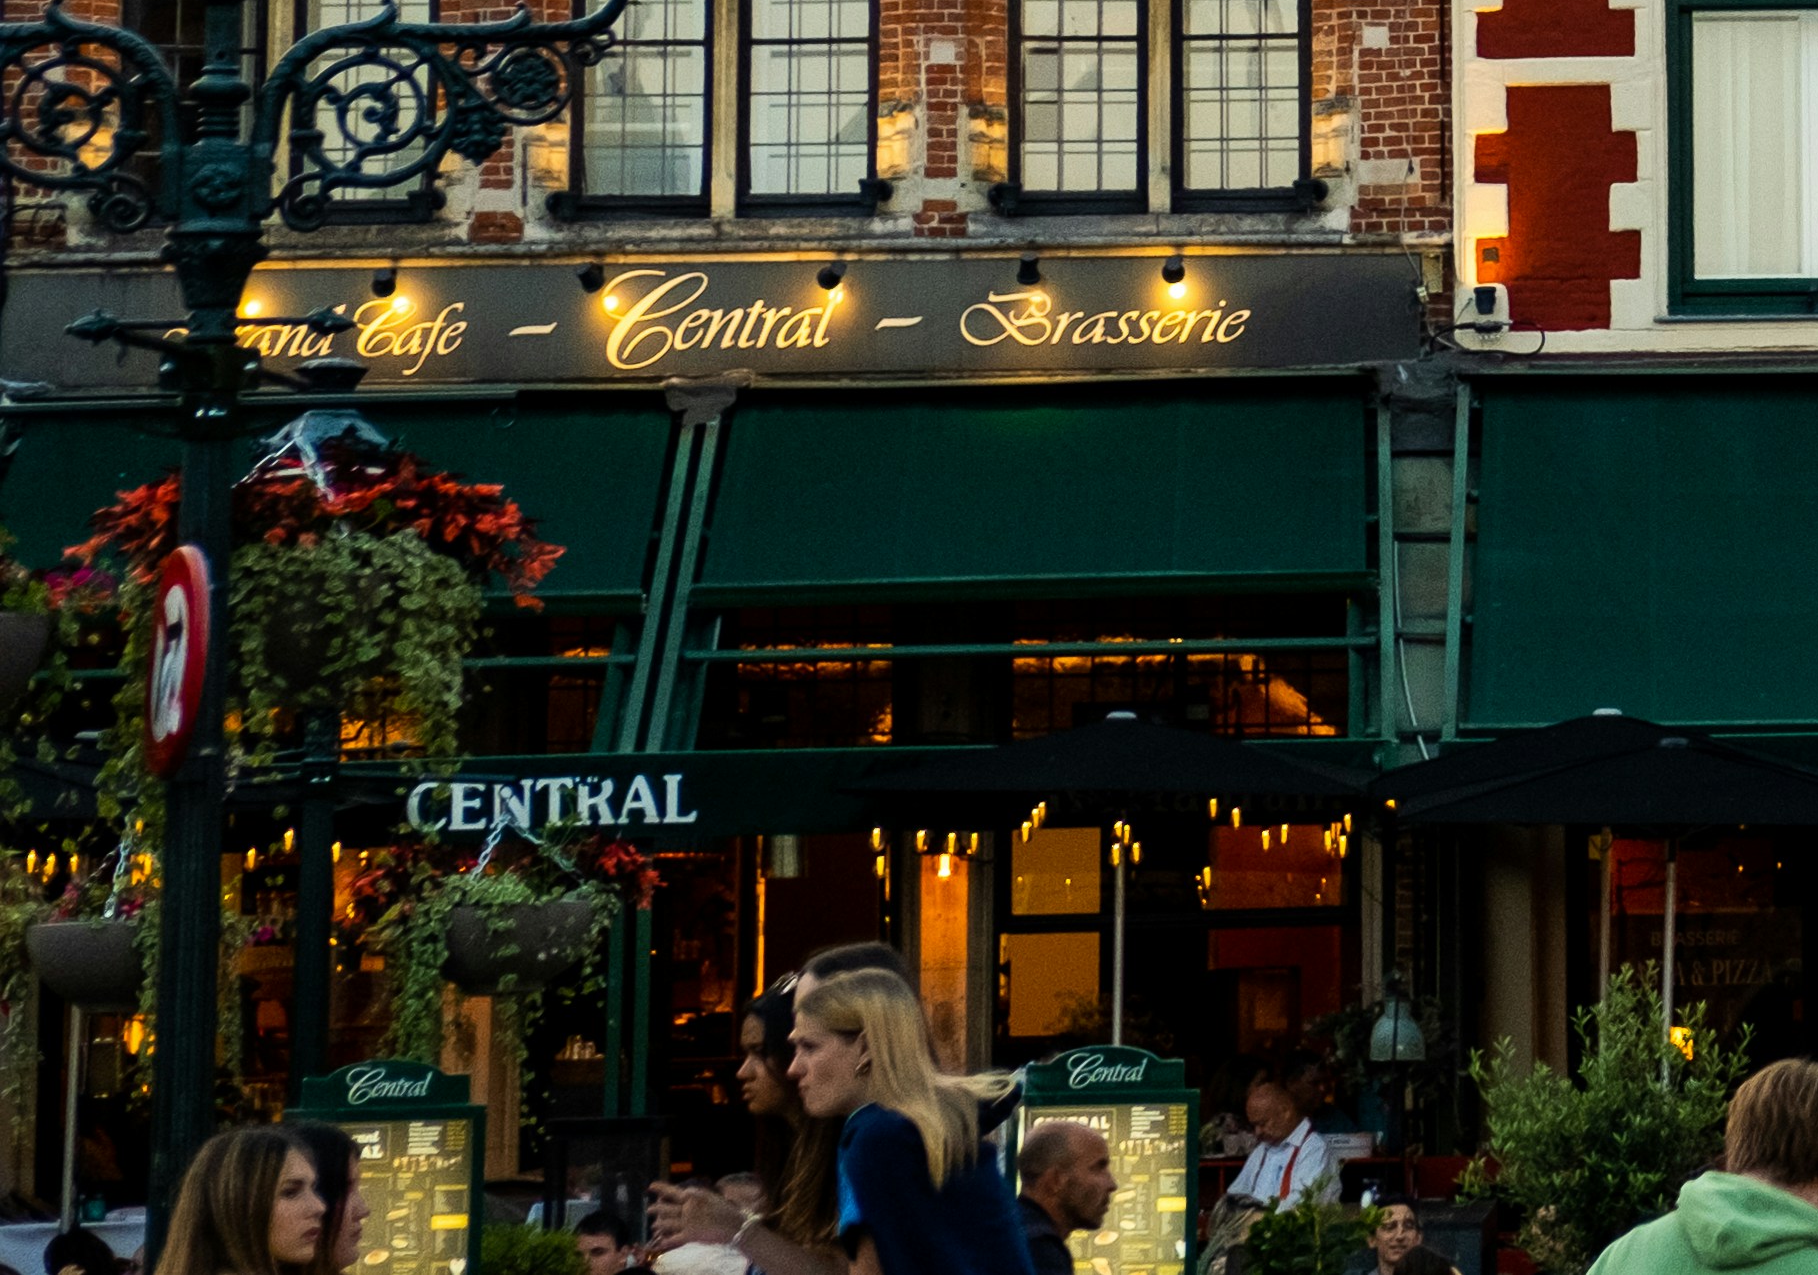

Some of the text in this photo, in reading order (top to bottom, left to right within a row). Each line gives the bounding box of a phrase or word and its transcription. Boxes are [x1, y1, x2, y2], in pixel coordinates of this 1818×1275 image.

[354, 299, 468, 375] Cafe
[601, 269, 843, 370] Central
[959, 291, 1252, 347] Brasserie
[405, 774, 698, 832] CENTRAL
[1651, 930, 1742, 947] BASSERIE
[1711, 959, 1776, 986] PIZZA
[346, 1065, 434, 1105] Central
[1067, 1052, 1149, 1090] Central
